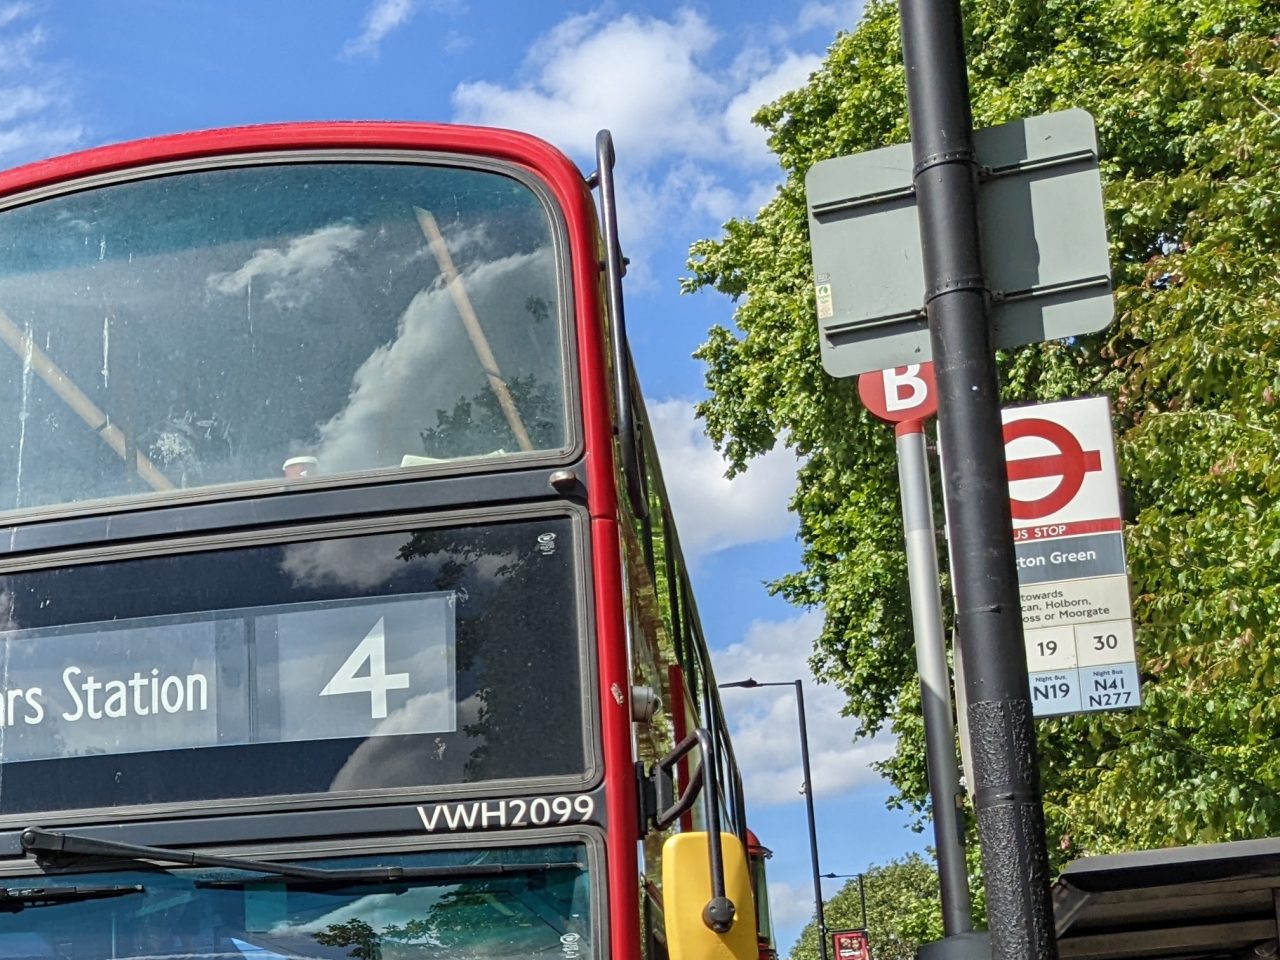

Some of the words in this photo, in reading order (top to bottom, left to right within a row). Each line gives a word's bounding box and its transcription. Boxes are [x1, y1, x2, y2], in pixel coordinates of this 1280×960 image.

[882, 363, 928, 412] B
[1014, 529, 1028, 540] US
[1034, 525, 1066, 538] STOP
[1016, 556, 1045, 570] ton
[1050, 550, 1096, 564] Green
[1021, 589, 1063, 602] towards
[1022, 614, 1041, 623] oss
[1059, 607, 1110, 619] Moorgate
[1037, 640, 1058, 656] 19
[1093, 634, 1118, 651] 30
[61, 665, 208, 721] Station
[318, 615, 411, 718] 4
[1093, 670, 1110, 678] Night
[1035, 675, 1053, 683] Night
[1094, 678, 1125, 692] N41
[1033, 682, 1070, 701] N19
[1089, 691, 1131, 708] N277
[416, 795, 594, 832] VWH2099
